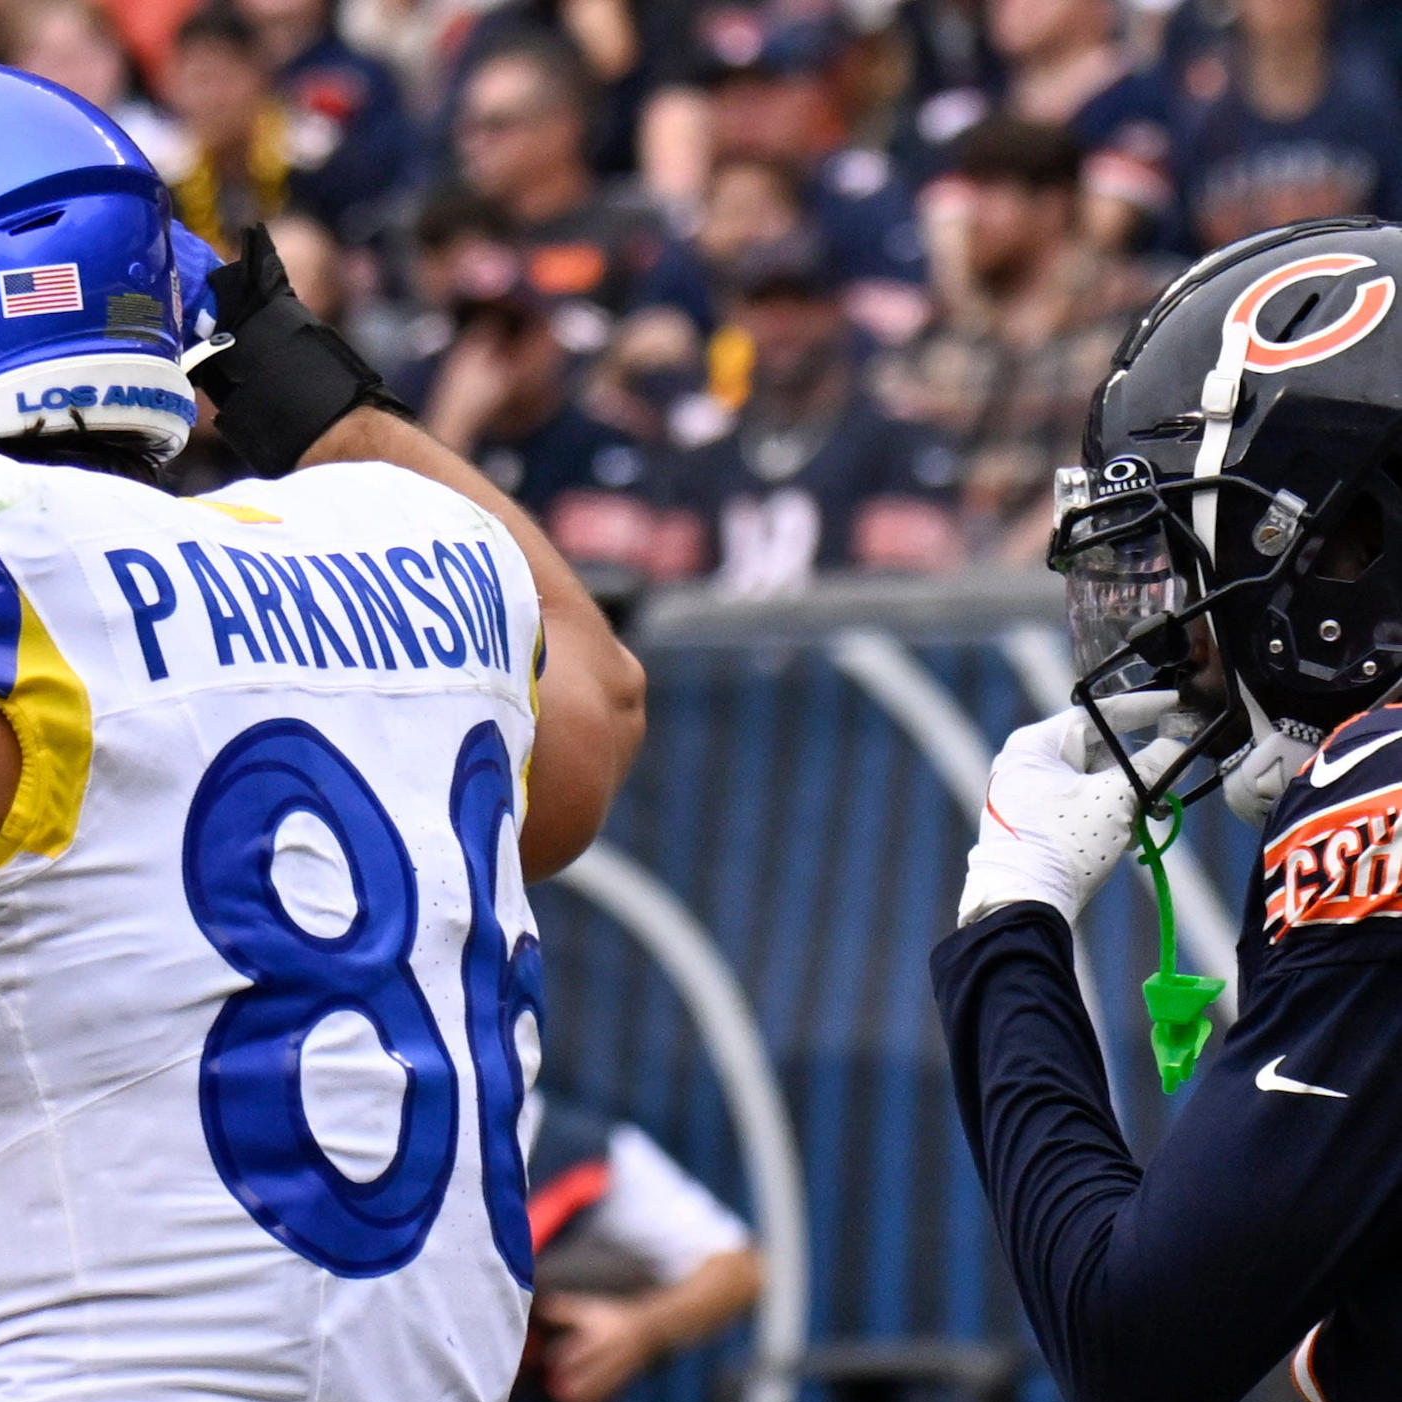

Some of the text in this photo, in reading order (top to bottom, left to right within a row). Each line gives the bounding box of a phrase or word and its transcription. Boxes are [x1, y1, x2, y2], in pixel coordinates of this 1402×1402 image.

[15, 385, 99, 414] LOS
[1098, 477, 1149, 496] OAKLEY
[103, 539, 511, 682] PARKINSON
